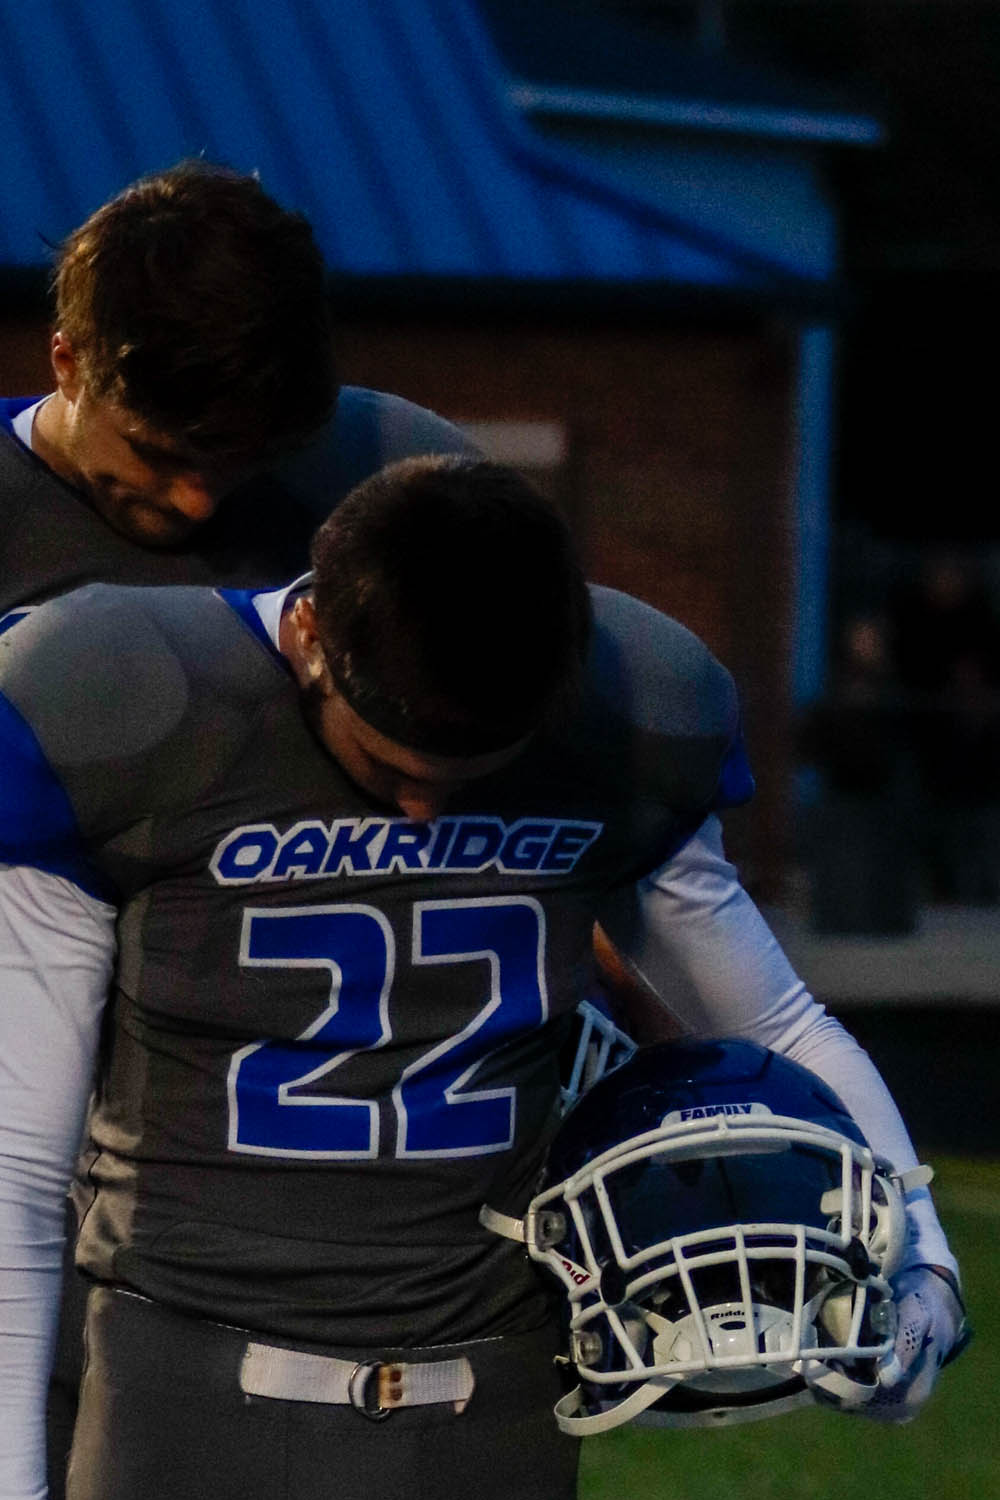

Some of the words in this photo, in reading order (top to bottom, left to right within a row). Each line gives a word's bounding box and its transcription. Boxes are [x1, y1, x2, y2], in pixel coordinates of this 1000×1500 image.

[209, 814, 605, 886] OAKRIDGE
[228, 896, 548, 1160] 22
[681, 1104, 752, 1121] FAMILY
